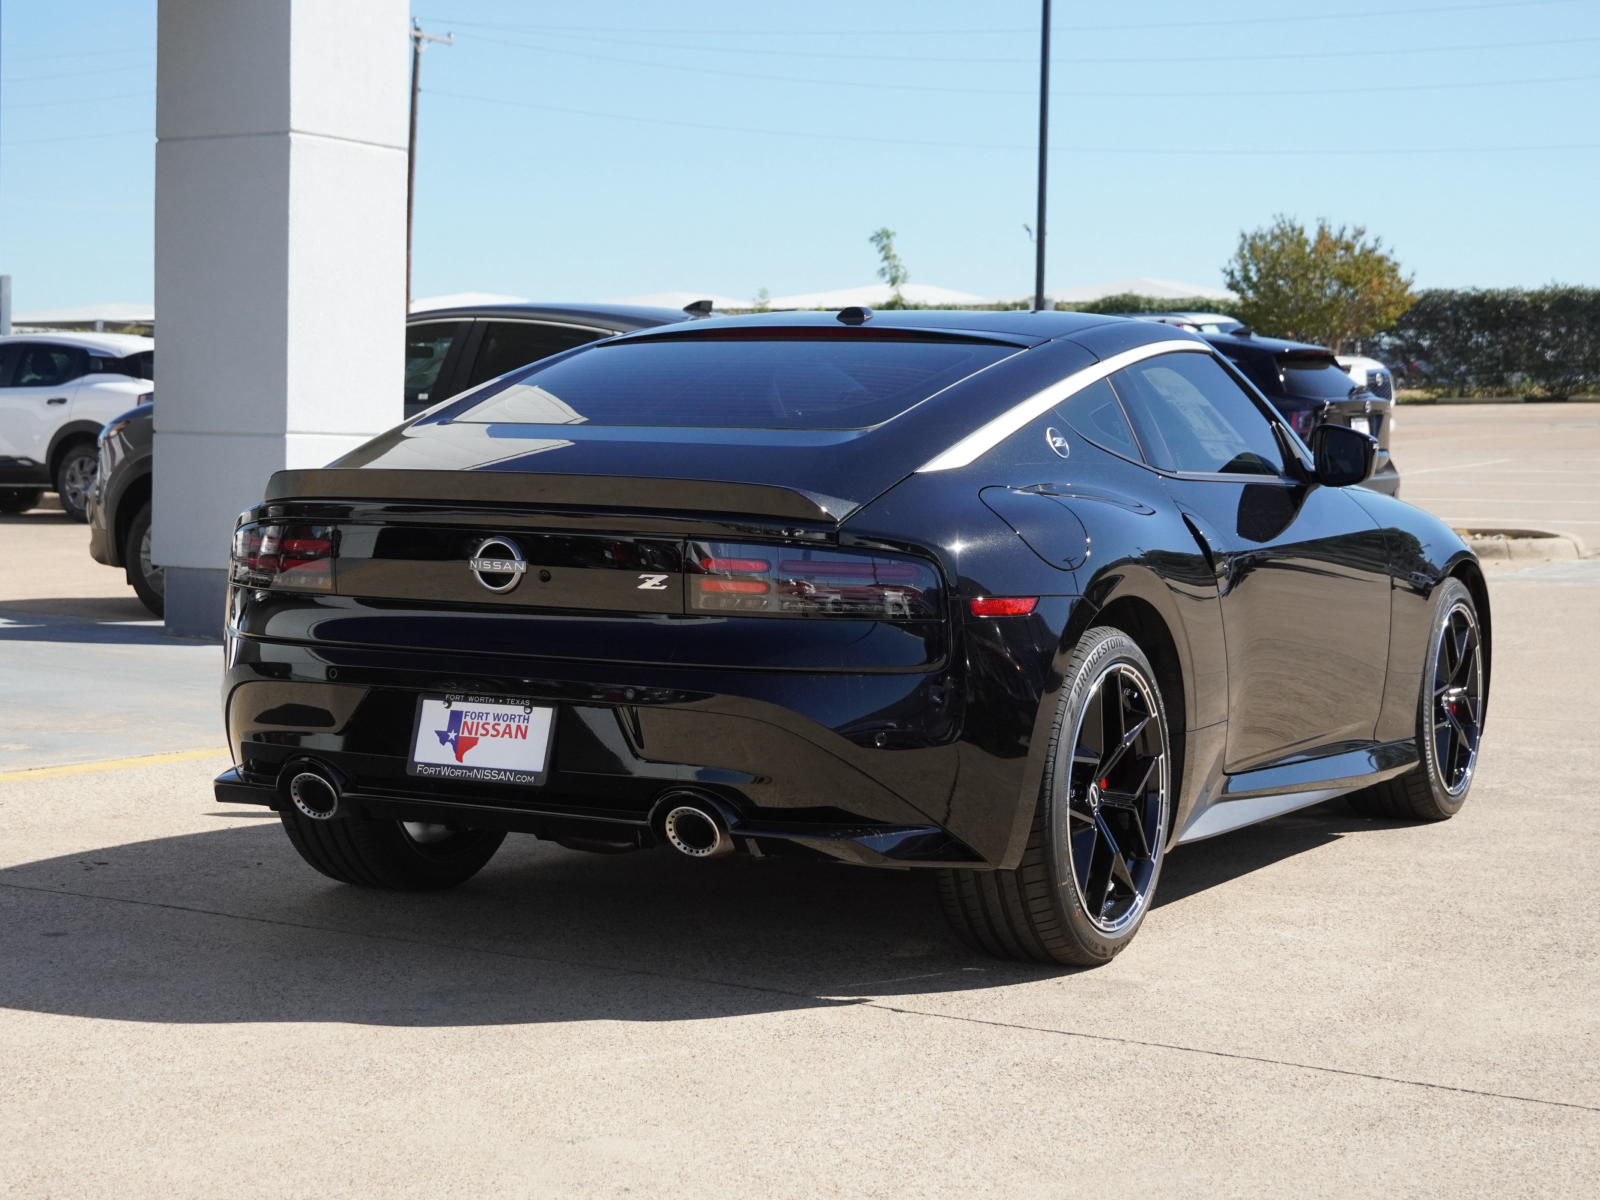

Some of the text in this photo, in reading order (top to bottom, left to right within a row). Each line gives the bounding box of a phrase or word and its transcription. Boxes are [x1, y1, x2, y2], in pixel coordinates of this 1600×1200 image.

[469, 559, 525, 571] NISSAN
[637, 574, 669, 590] Z
[1074, 637, 1126, 699] BRIDGESTONE
[506, 698, 531, 706] TEXAS
[463, 711, 530, 724] FORT WORTH
[461, 721, 529, 740] NISSAN
